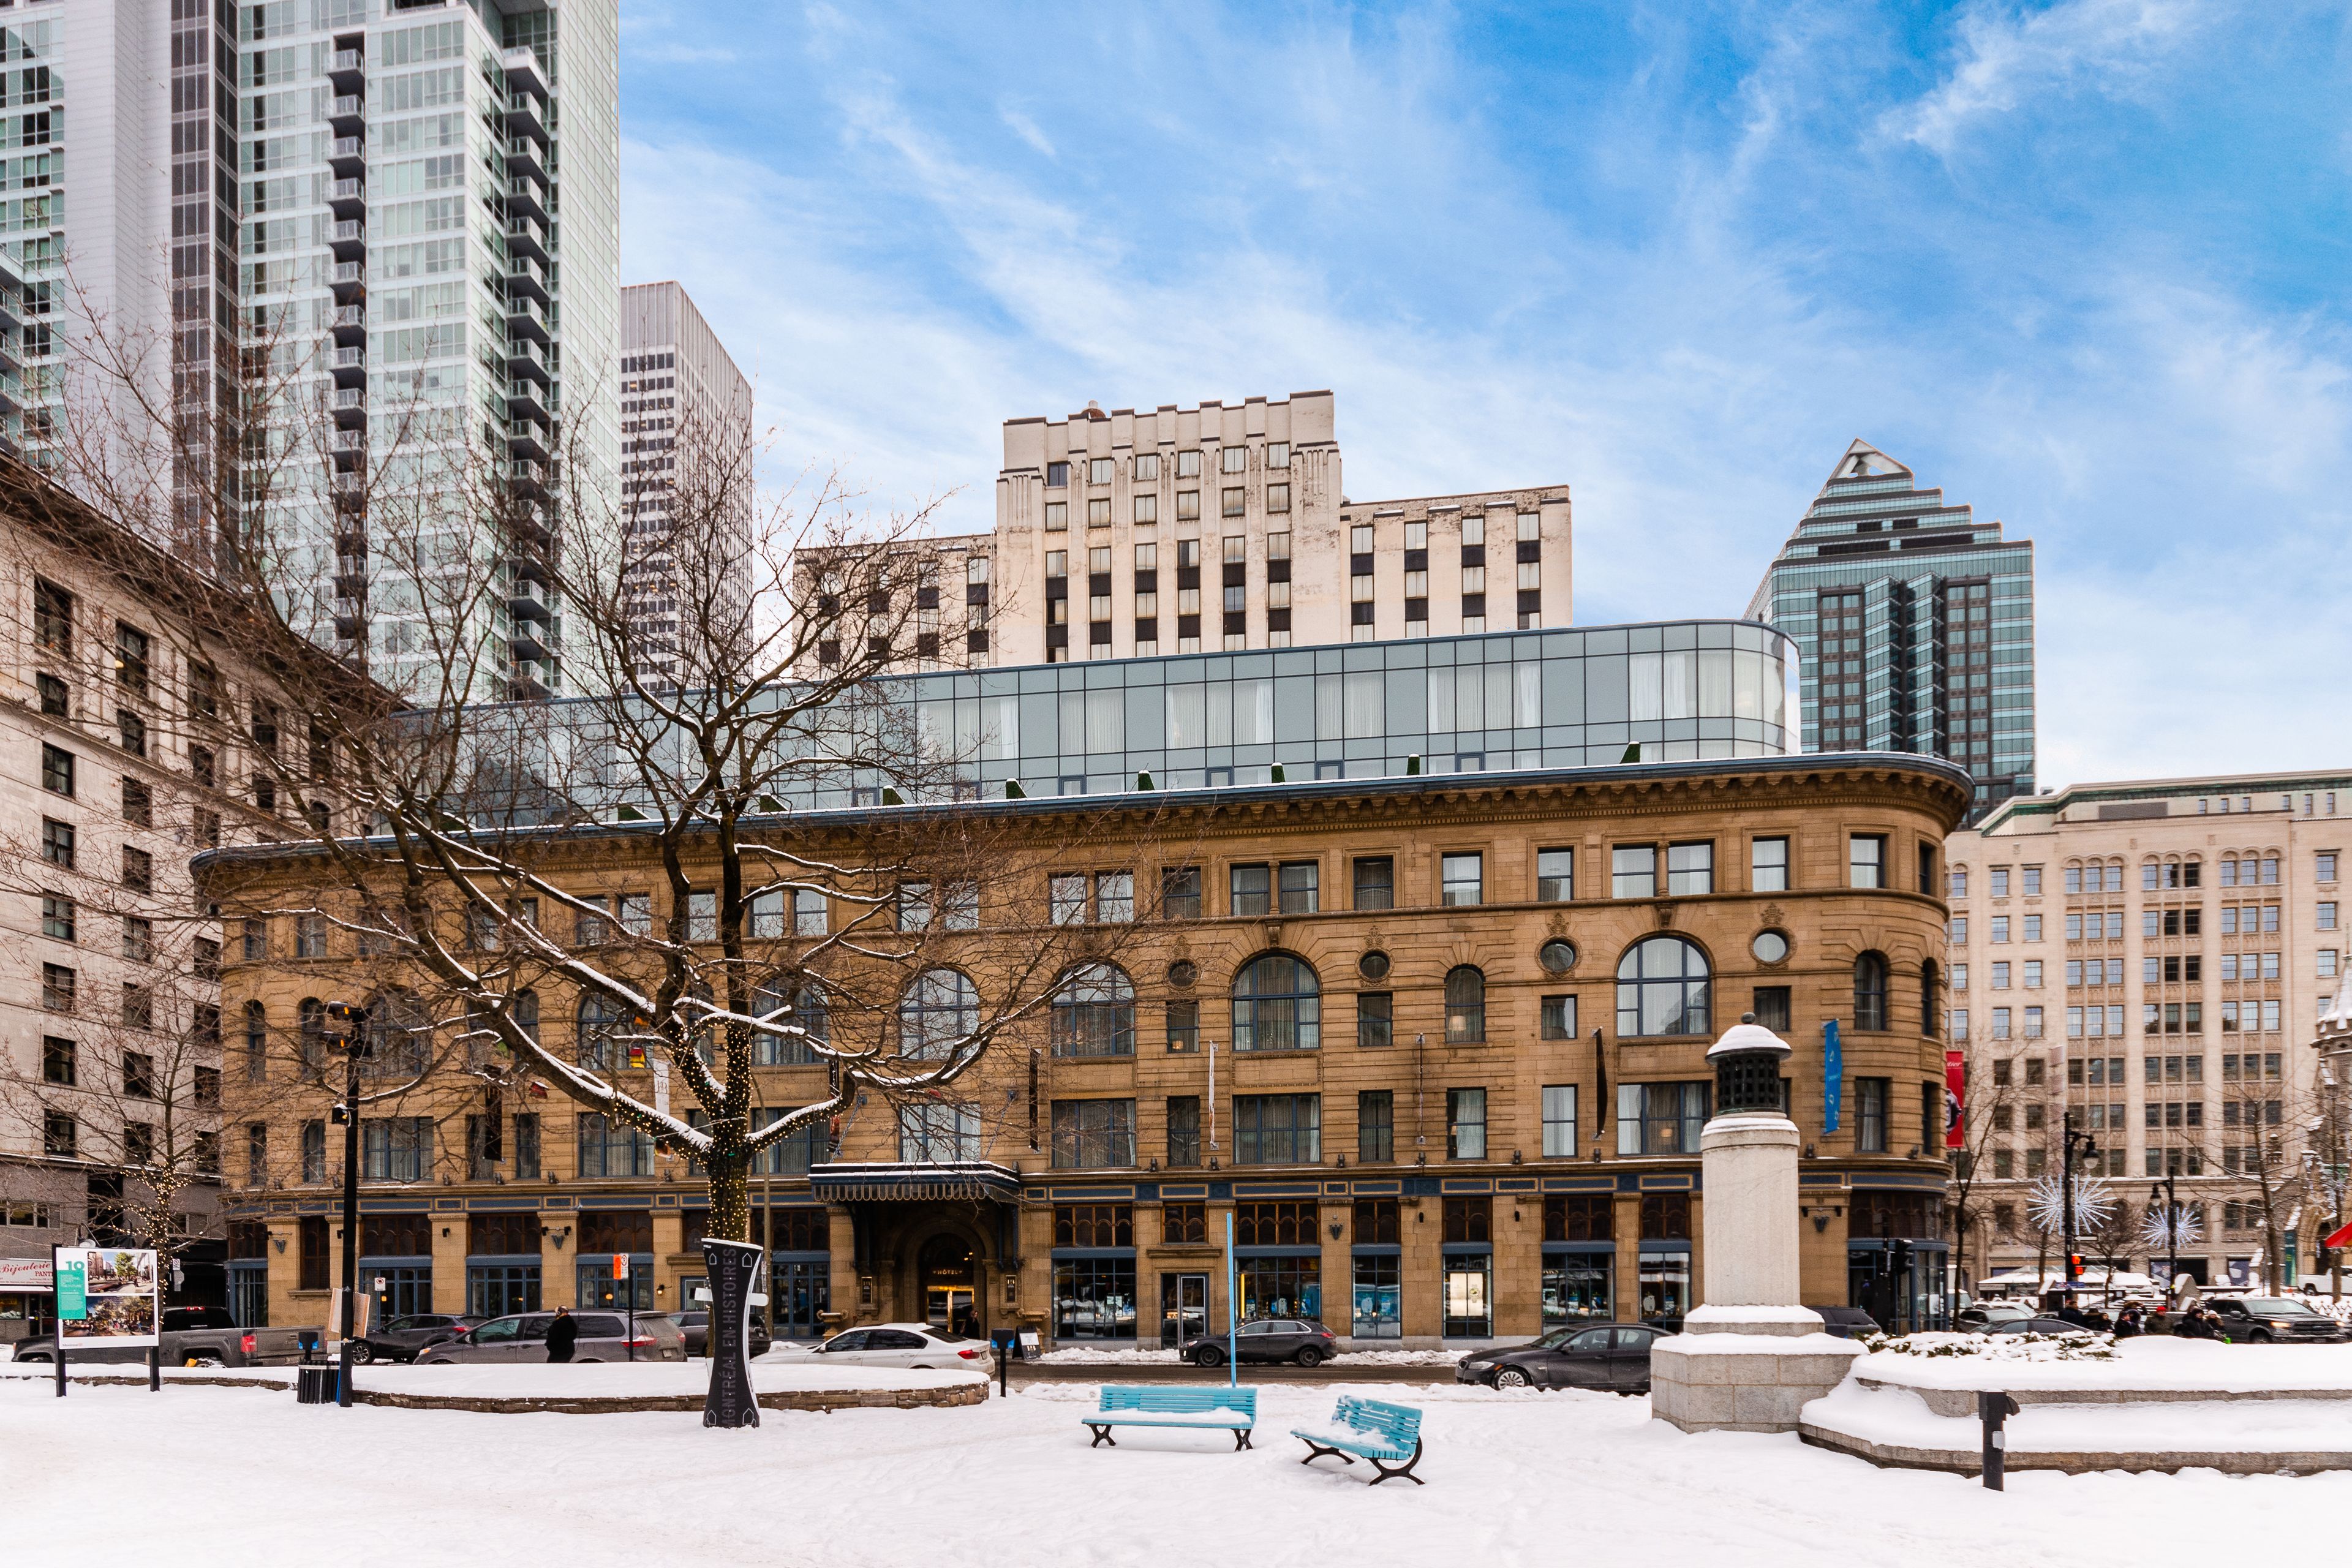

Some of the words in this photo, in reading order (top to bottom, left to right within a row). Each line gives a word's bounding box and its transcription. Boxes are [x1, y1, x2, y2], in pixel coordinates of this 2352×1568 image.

[1, 1261, 50, 1275] Bijouterie
[723, 1248, 736, 1323] HISTOIRES
[723, 1330, 736, 1347] EN
